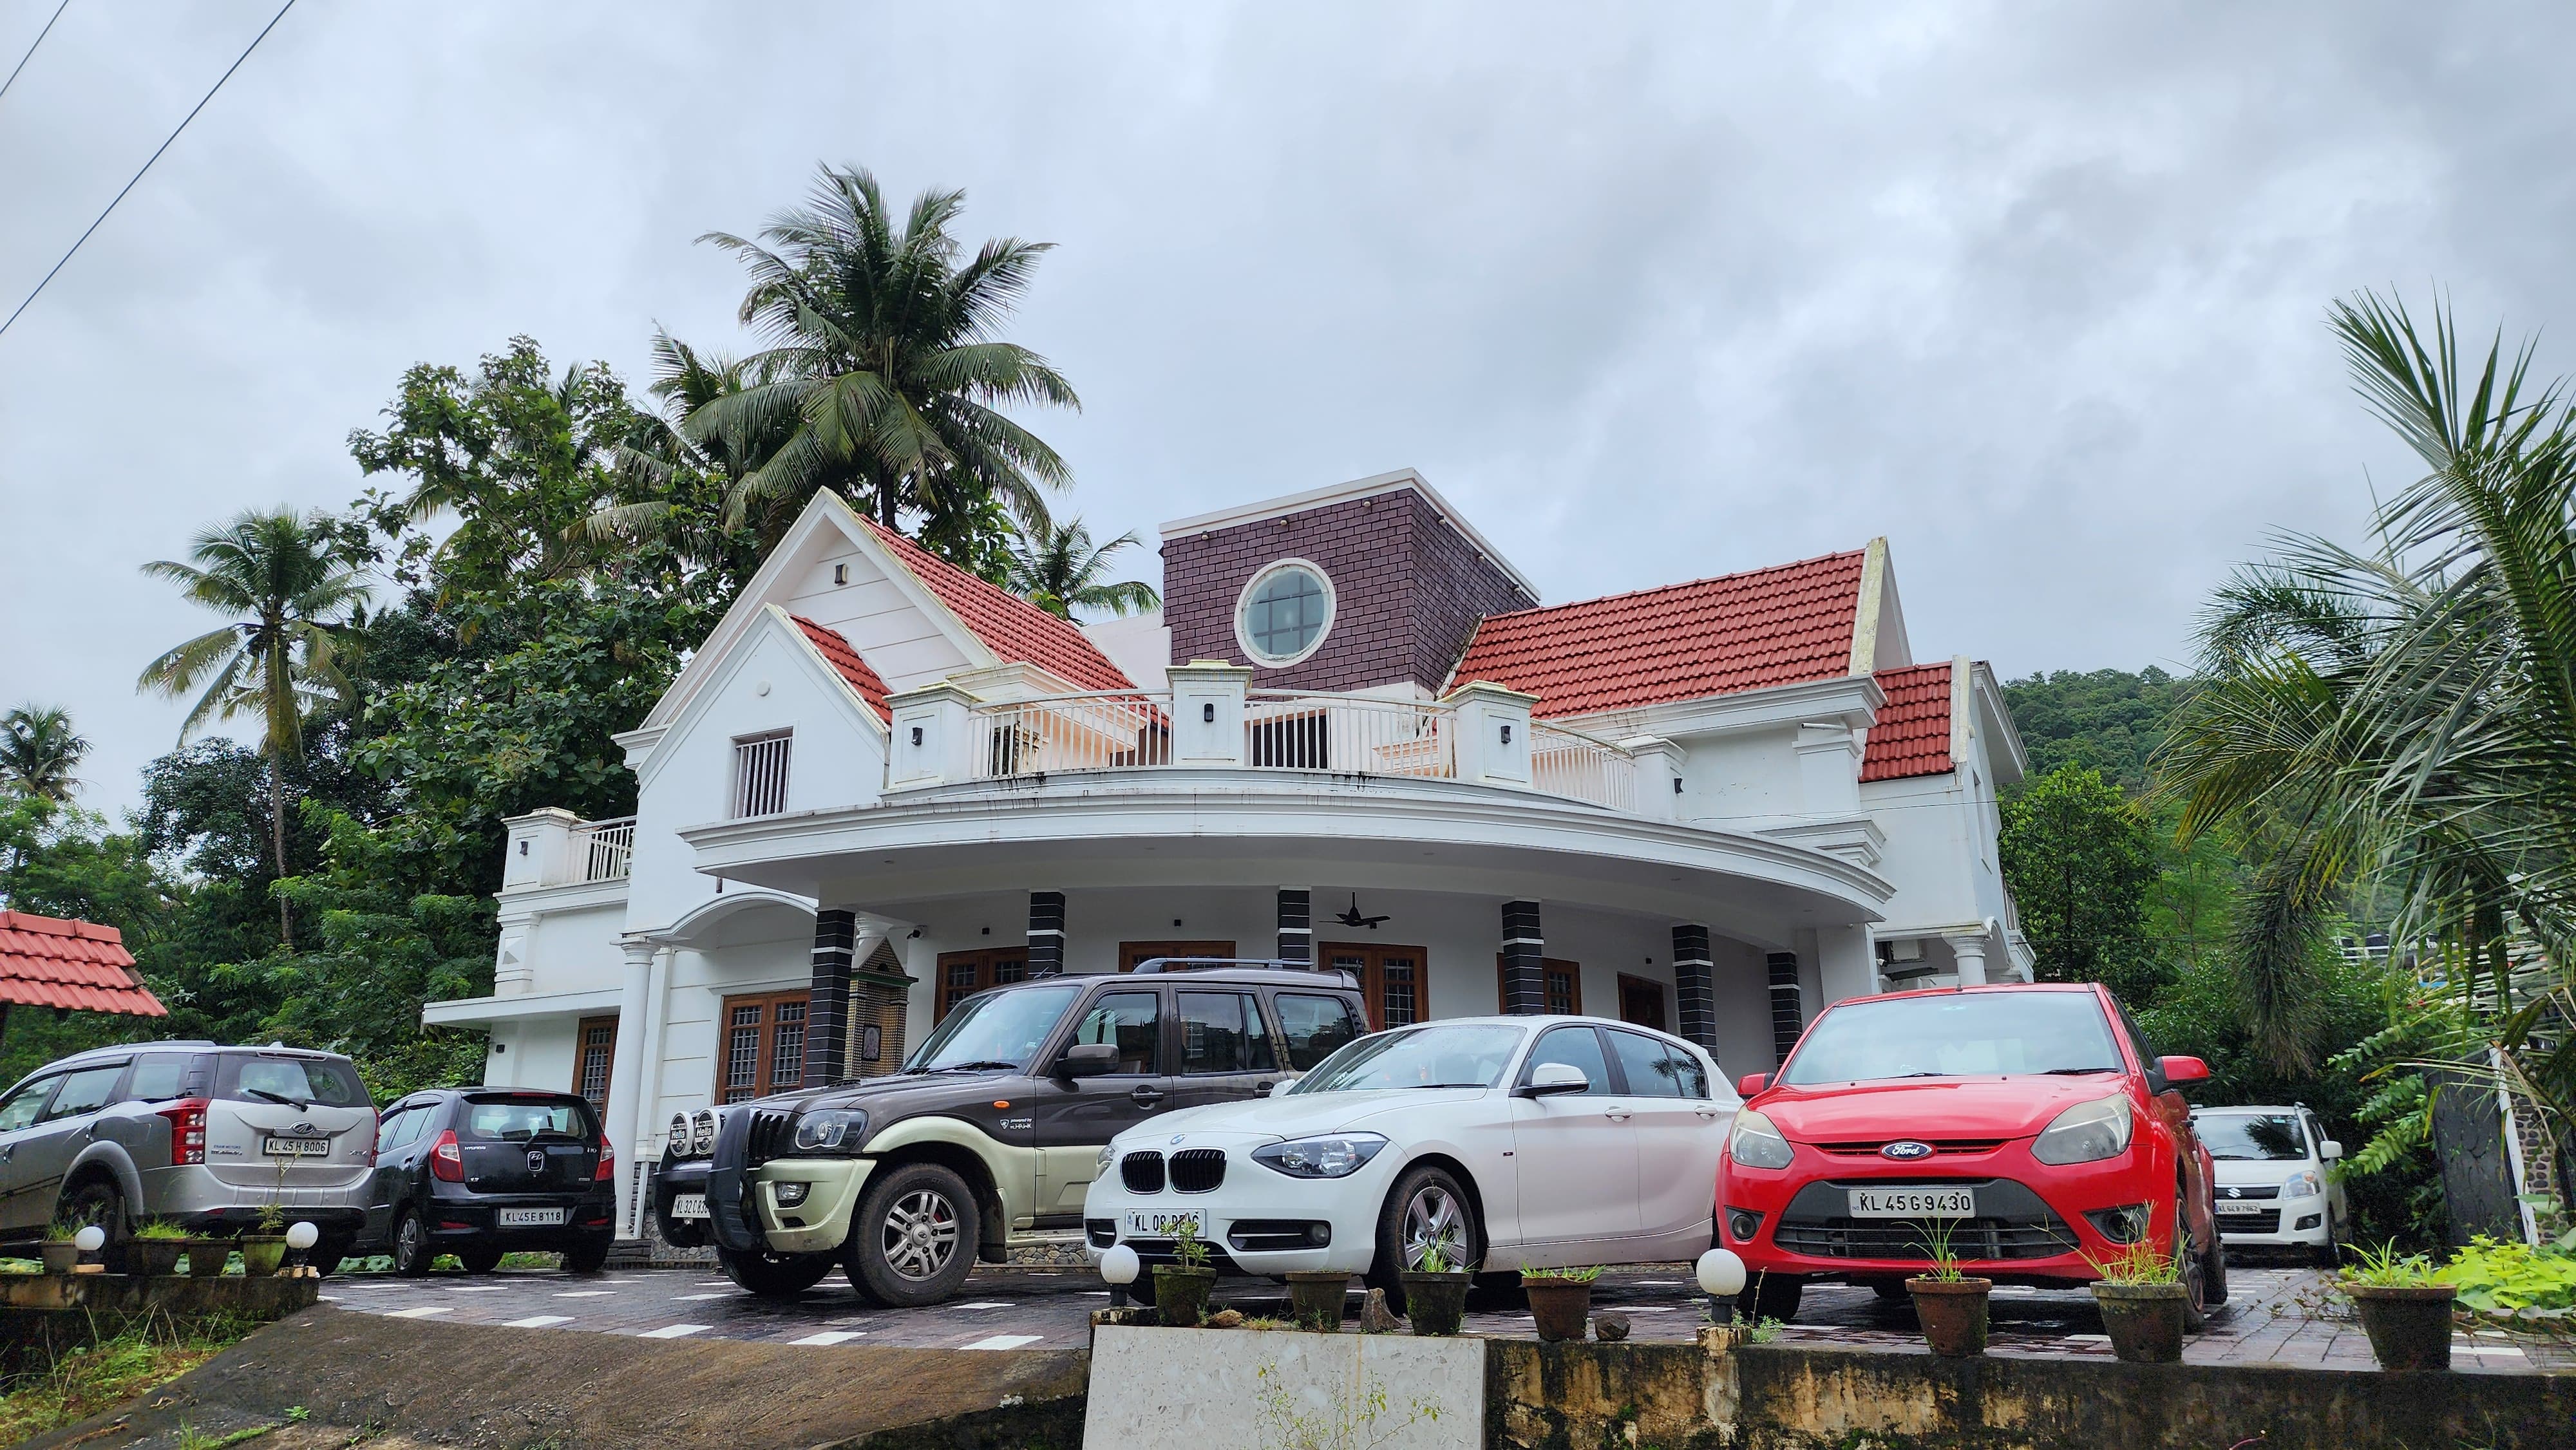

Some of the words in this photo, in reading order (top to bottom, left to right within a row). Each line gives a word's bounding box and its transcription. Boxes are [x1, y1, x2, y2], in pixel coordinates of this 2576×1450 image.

[672, 1130, 685, 1139] Hella
[696, 1127, 712, 1137] Hella
[268, 1140, 279, 1151] KL
[283, 1140, 294, 1151] 45
[296, 1142, 302, 1152] H
[304, 1142, 326, 1152] 8006
[1892, 1144, 1920, 1156] Ford
[1859, 1195, 1882, 1211] KL
[1135, 1214, 1148, 1231] KL
